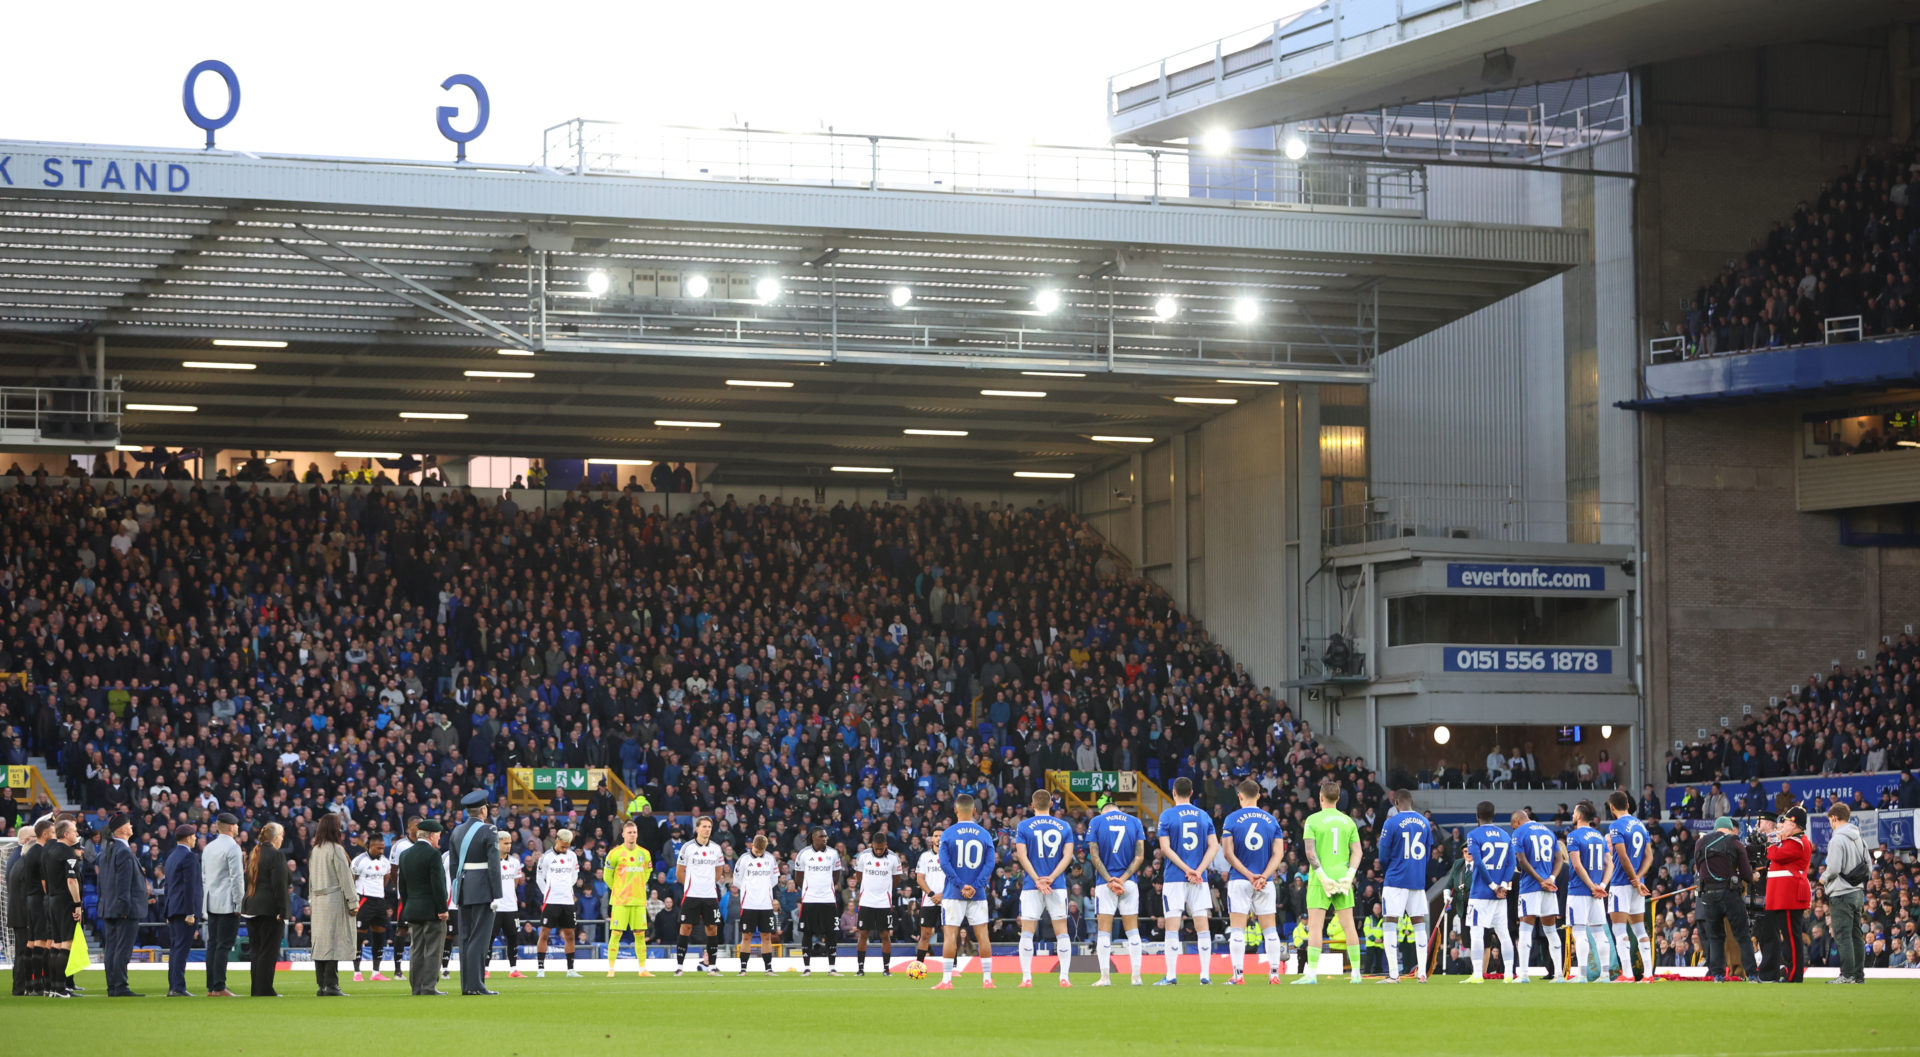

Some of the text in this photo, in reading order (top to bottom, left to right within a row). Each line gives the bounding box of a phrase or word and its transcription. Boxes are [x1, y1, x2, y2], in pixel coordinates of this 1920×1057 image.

[42, 157, 190, 193] STAND
[1461, 567, 1591, 588] evertonfc.com
[1457, 650, 1599, 671] 0151 556 1878
[1309, 689, 1319, 701] Z
[536, 775, 552, 783] Exit
[1071, 777, 1090, 786] EXIT
[1815, 787, 1853, 799] CASTORE
[1178, 809, 1200, 818] KEANE
[1236, 813, 1273, 825] TARKOWSKI
[957, 828, 980, 836] NDIAYE
[1033, 829, 1062, 858] 19
[1108, 825, 1126, 854] 7
[1182, 822, 1199, 851] 5
[1244, 822, 1264, 851] 6
[1330, 827, 1339, 855] 1
[1402, 831, 1426, 860] 16
[1632, 831, 1644, 858] 9
[955, 839, 983, 869] 10
[1481, 842, 1509, 870] 27
[1529, 834, 1554, 862] 18
[1588, 843, 1603, 871] 11
[713, 909, 721, 919] 16
